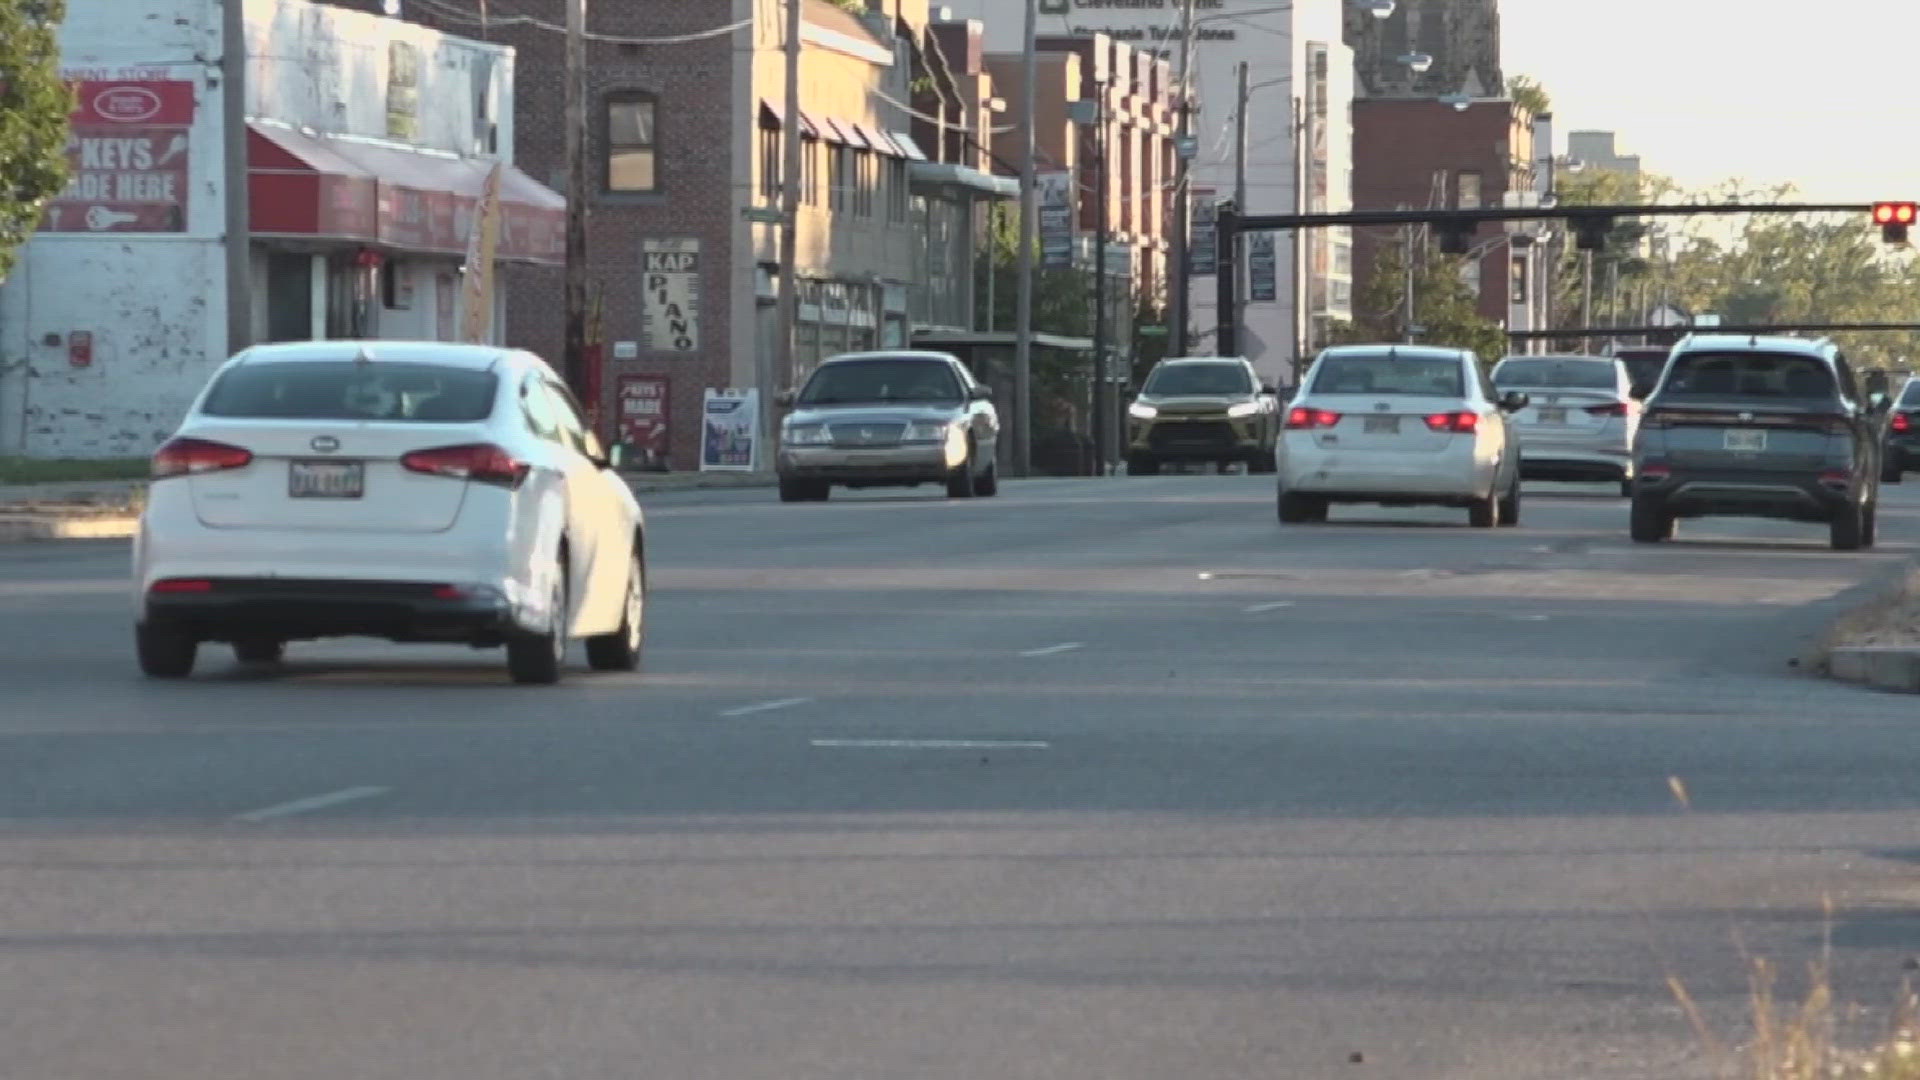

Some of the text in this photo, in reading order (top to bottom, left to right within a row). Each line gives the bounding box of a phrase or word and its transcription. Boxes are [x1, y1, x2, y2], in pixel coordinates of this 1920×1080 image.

[1196, 25, 1234, 40] Jones
[82, 138, 153, 169] KEYS
[117, 173, 177, 201] HERE
[648, 253, 694, 270] KAP
[649, 276, 693, 350] PIANO
